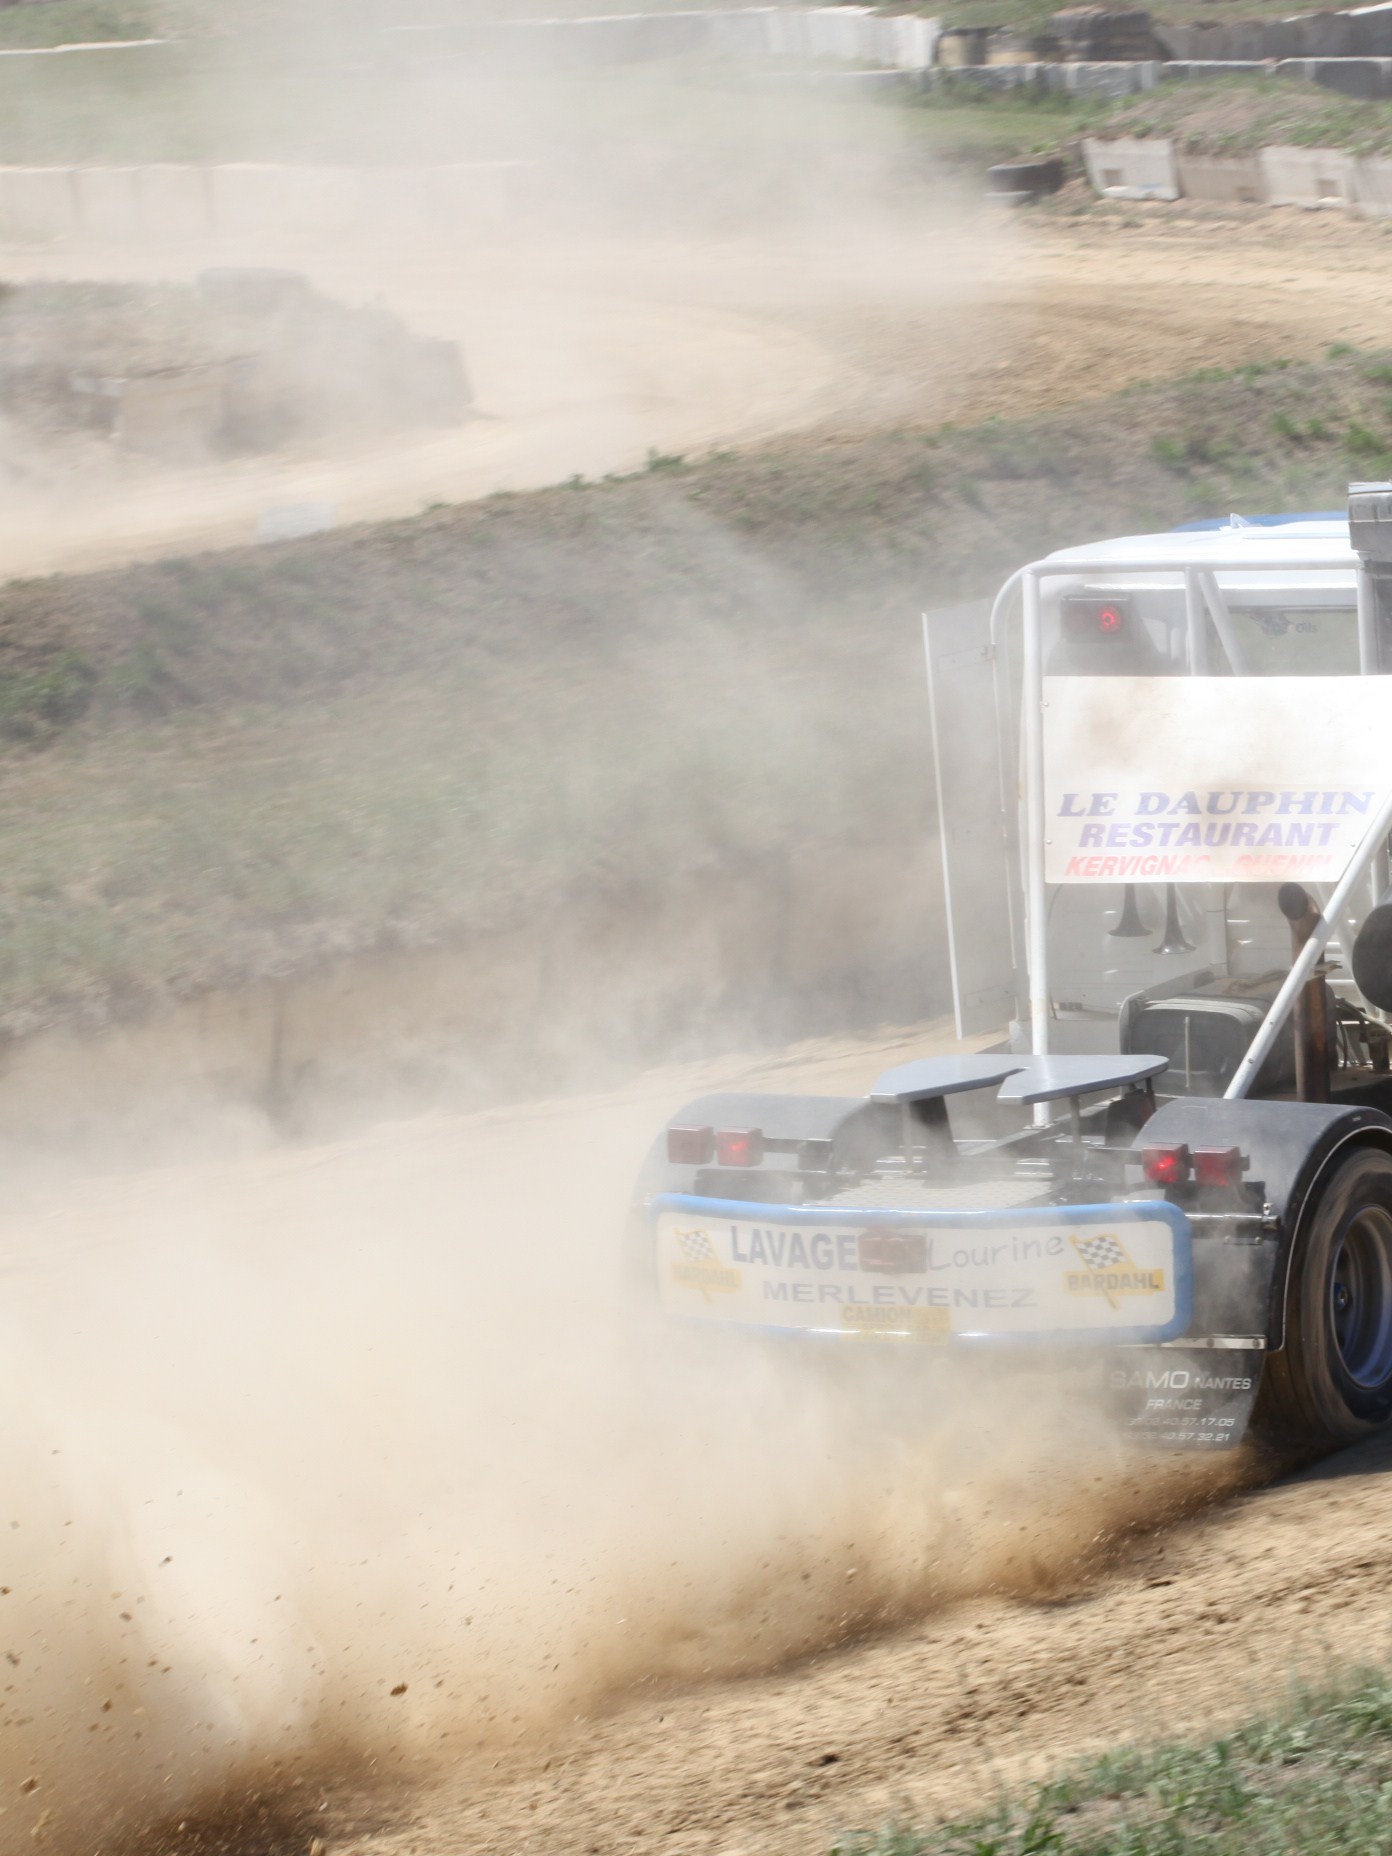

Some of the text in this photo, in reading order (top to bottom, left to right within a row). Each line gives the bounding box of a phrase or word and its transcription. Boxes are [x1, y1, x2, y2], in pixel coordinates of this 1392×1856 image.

[1057, 790, 1376, 817] LE DAUPHIN
[1078, 821, 1340, 848] RESTAURANT
[731, 1225, 858, 1272] LAVAGE
[763, 1280, 1037, 1308] MERLEVENEZ
[1067, 1270, 1160, 1292] BARDAHL
[1194, 1377, 1253, 1390] NANTES
[1145, 1398, 1203, 1411] FRANCE
